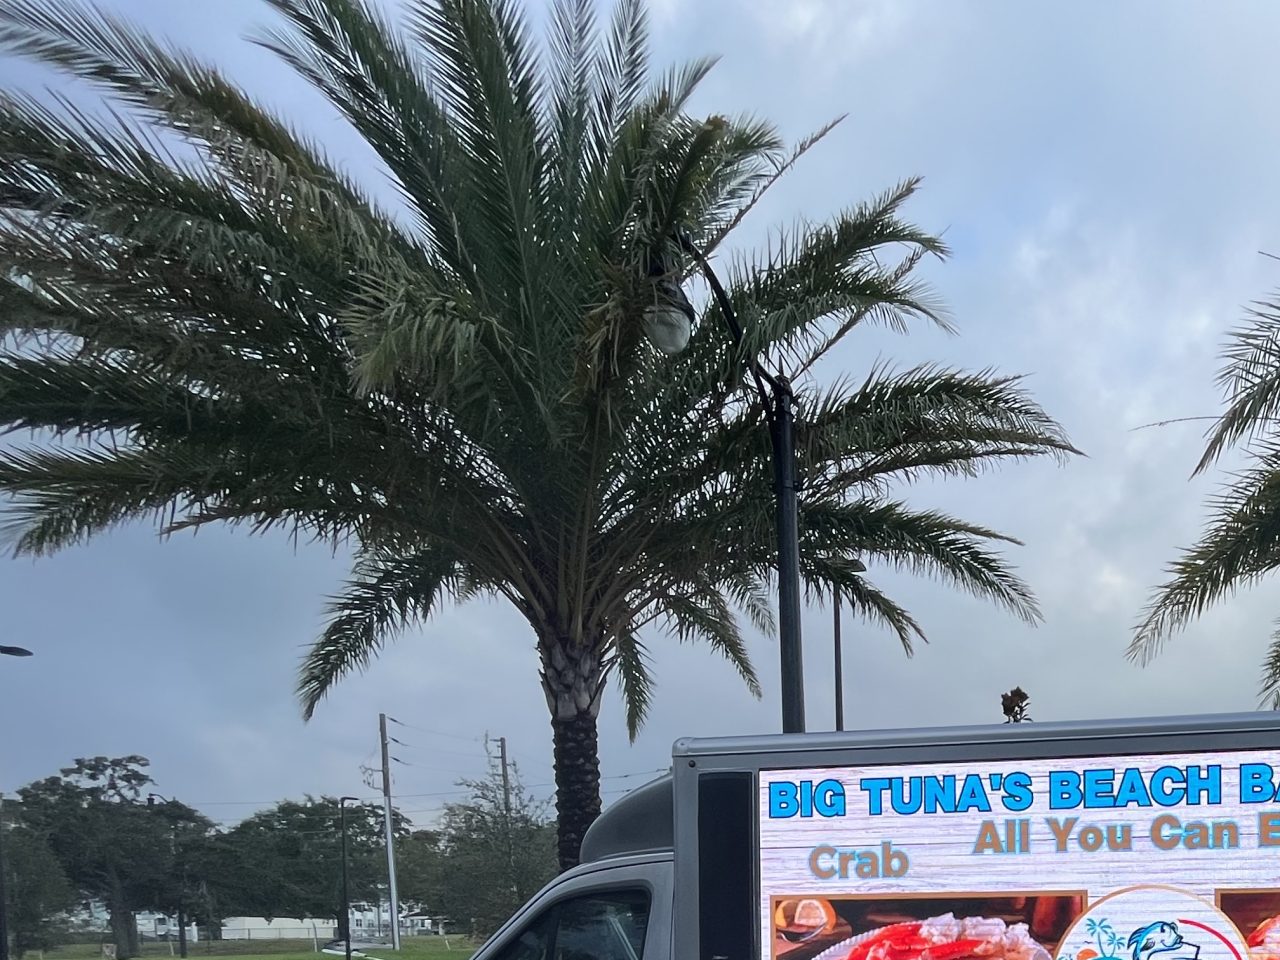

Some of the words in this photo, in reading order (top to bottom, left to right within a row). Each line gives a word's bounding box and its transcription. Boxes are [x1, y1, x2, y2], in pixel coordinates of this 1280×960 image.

[769, 779, 846, 818] BIG
[860, 772, 1034, 816] TUNA'S
[1048, 763, 1222, 809] BEACH
[973, 819, 1031, 854] All
[1045, 816, 1133, 852] You
[1150, 813, 1239, 850] Can
[808, 840, 910, 879] Crab
